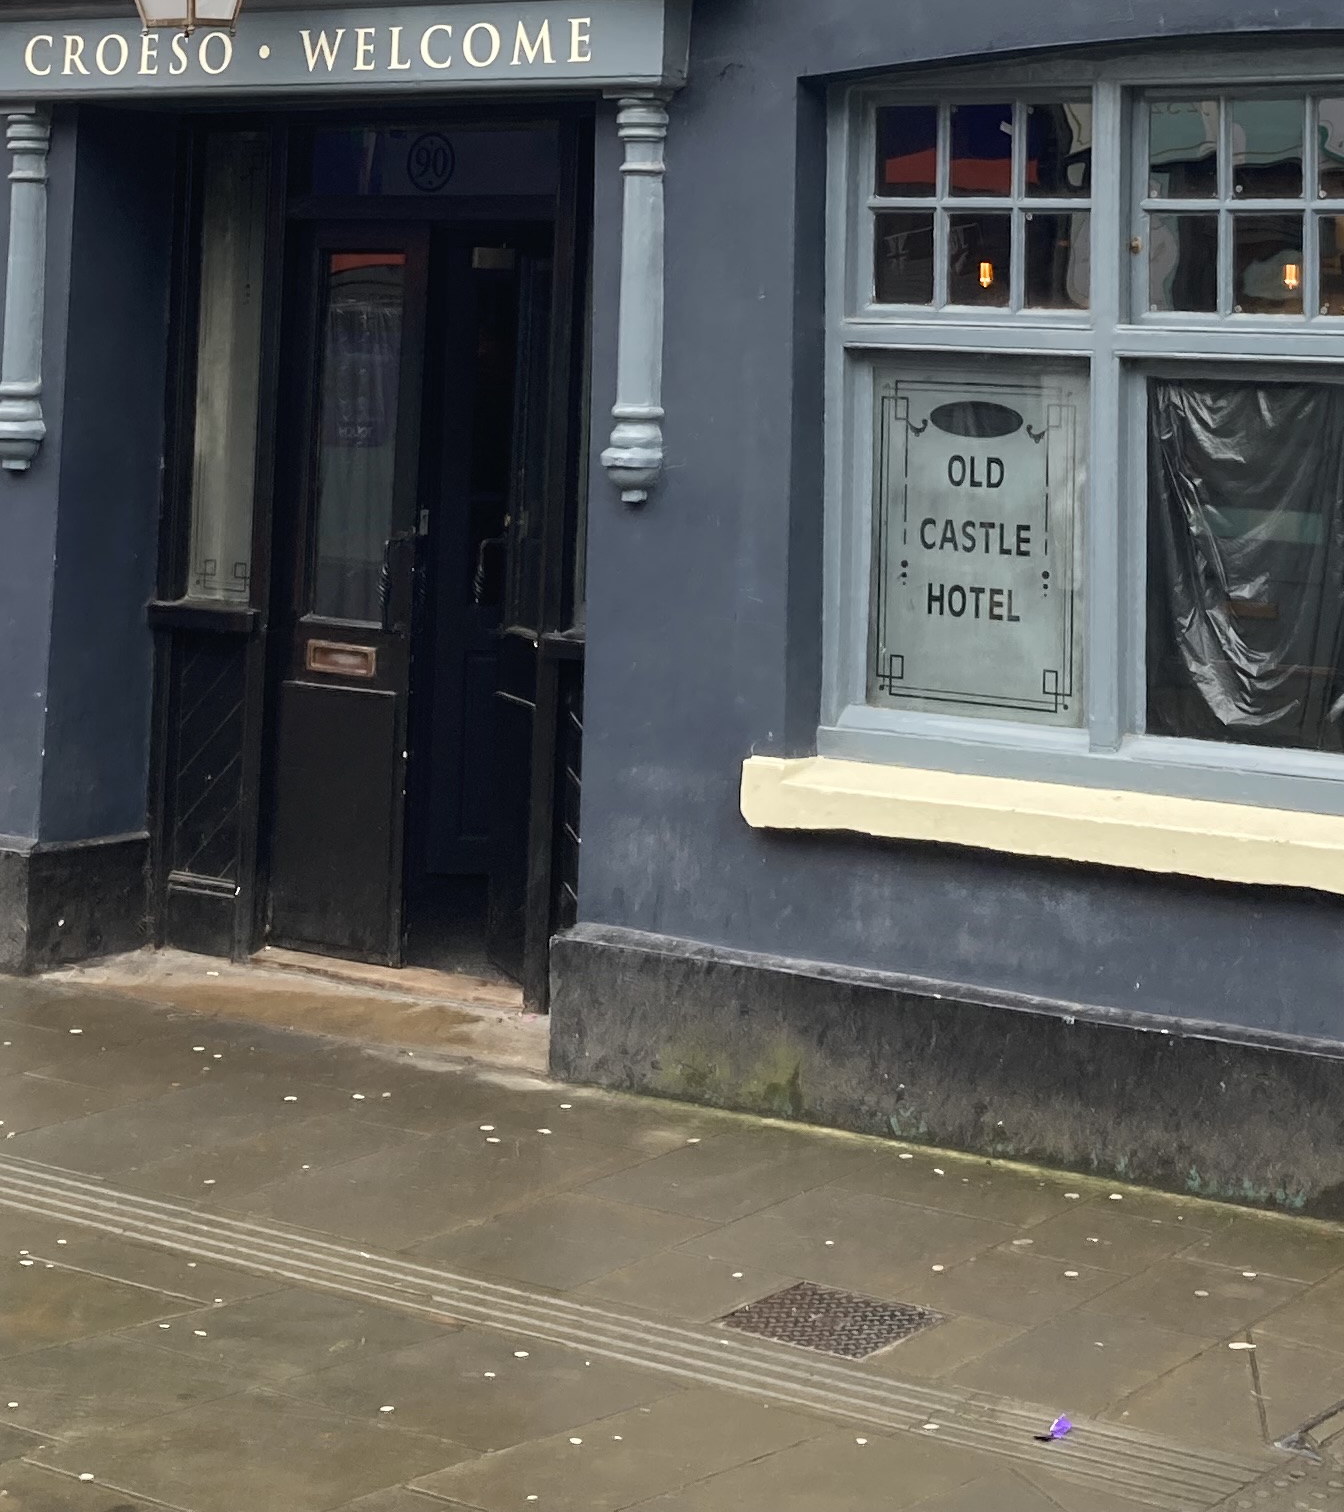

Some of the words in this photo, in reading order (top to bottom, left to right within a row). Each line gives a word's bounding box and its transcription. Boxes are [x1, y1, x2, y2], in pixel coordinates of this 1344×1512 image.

[24, 31, 233, 76] CROESO
[299, 17, 592, 72] WELCOME
[416, 148, 448, 177] 90
[947, 454, 1004, 488] OLD
[920, 517, 1031, 557] CASTLE
[927, 582, 1020, 622] HOTEL
